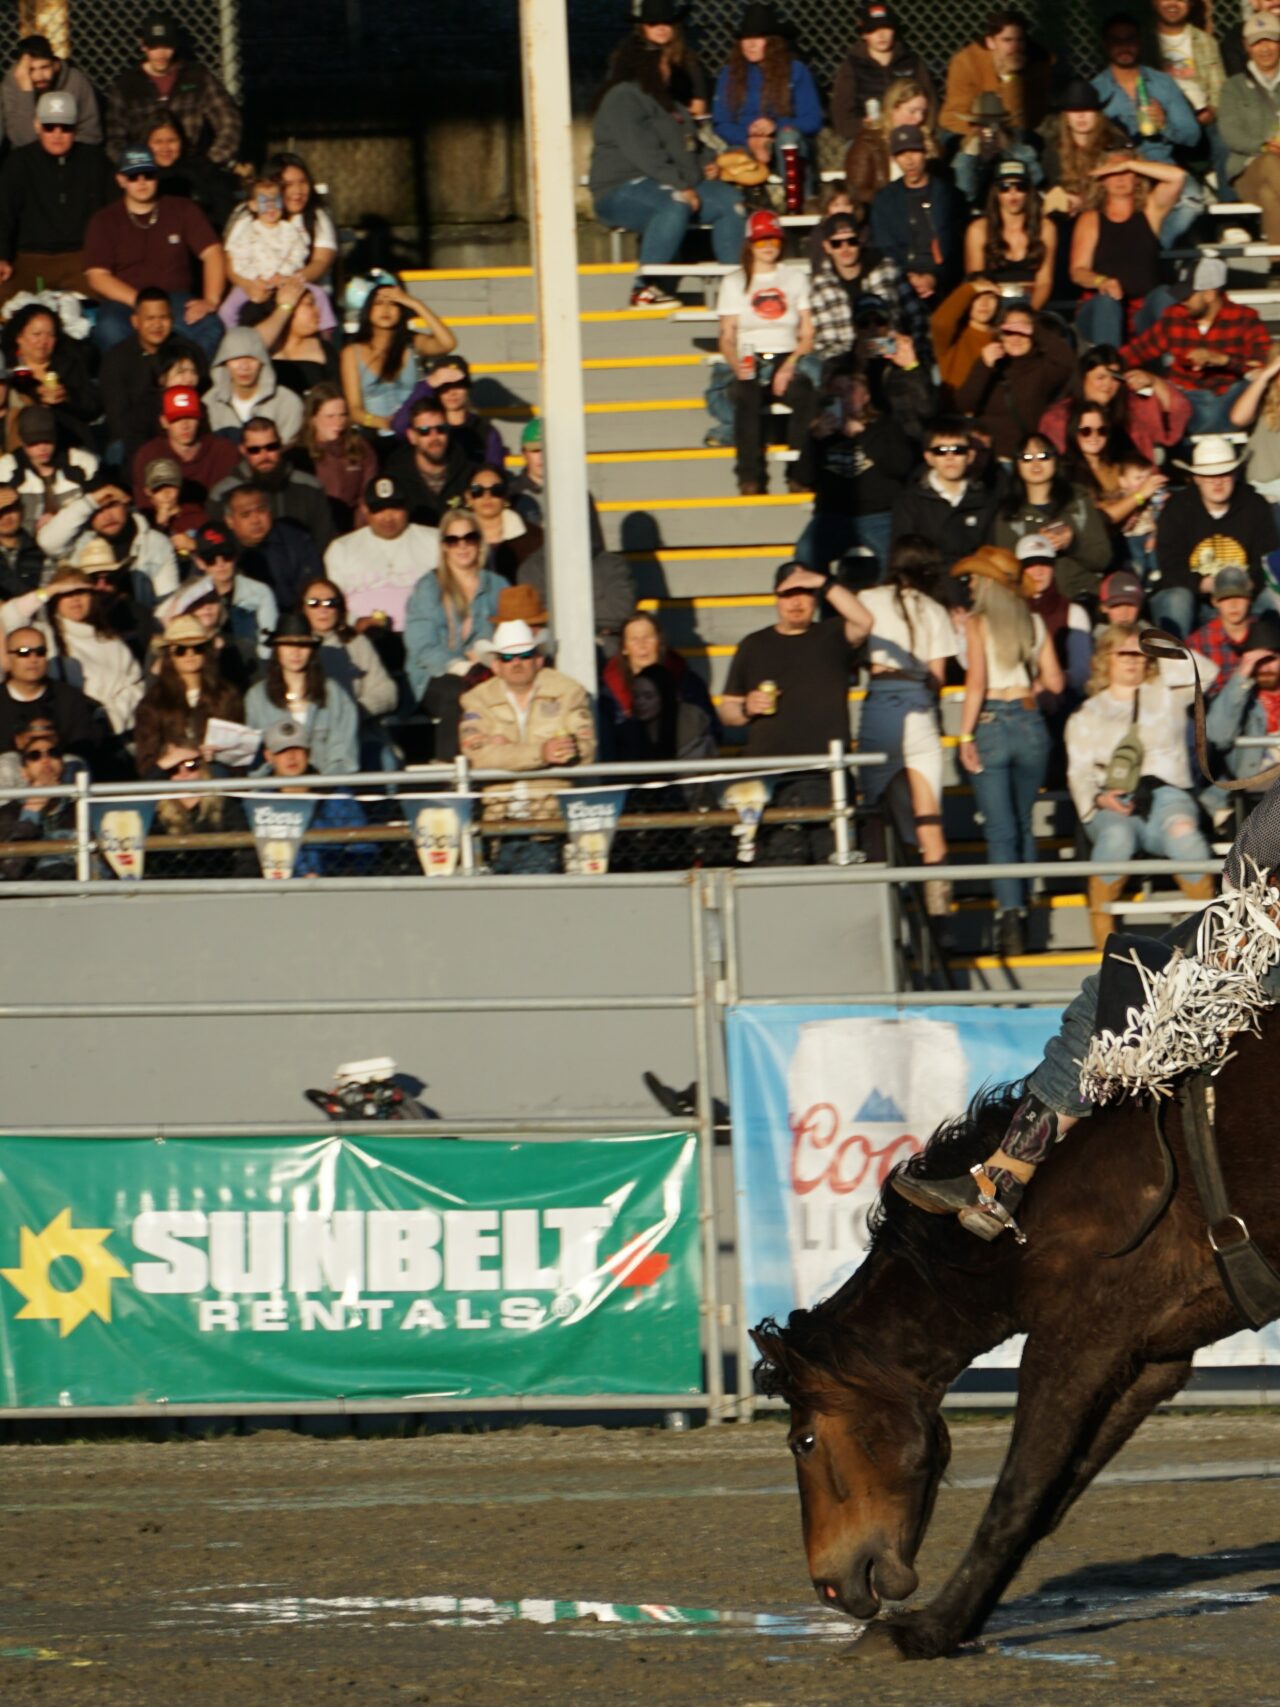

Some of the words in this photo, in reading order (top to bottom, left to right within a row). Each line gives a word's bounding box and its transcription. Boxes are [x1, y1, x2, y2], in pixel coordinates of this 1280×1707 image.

[788, 1102, 926, 1195] Coo
[132, 1207, 608, 1294] SUNBELT
[200, 1299, 540, 1331] RENTALS
